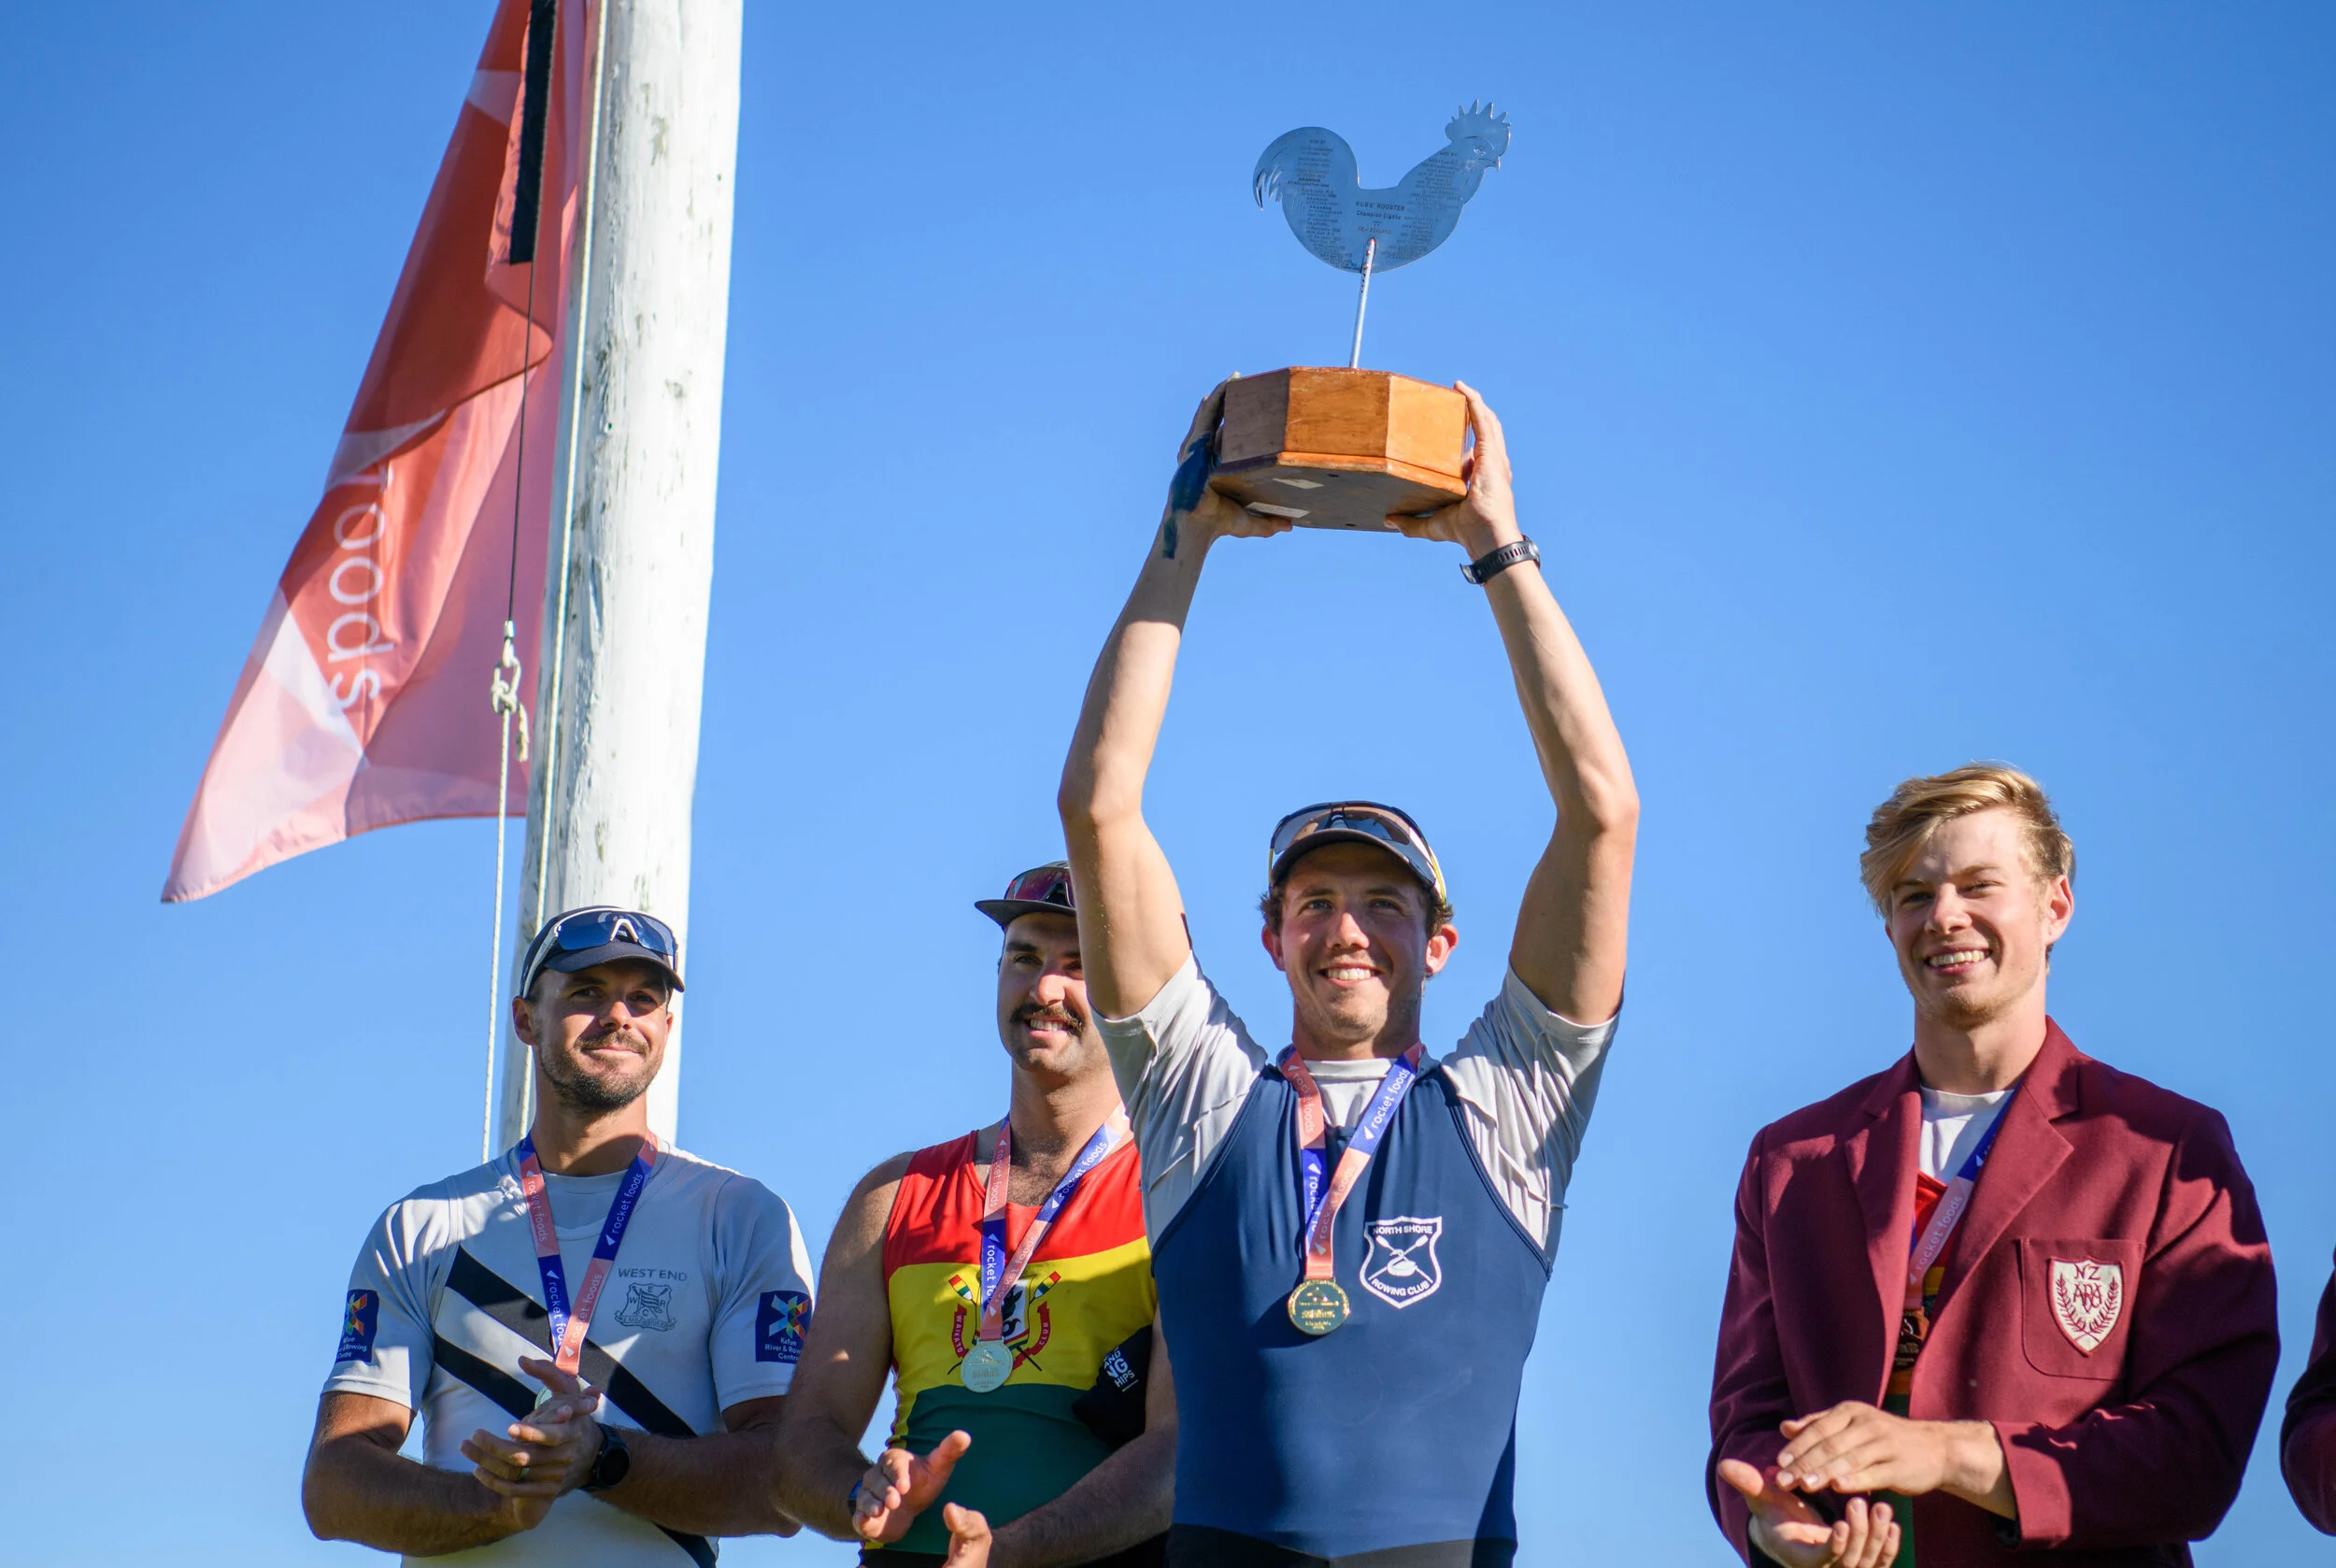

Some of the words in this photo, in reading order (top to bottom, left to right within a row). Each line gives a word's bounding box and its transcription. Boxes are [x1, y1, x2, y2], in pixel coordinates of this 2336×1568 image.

[1371, 1095, 1395, 1130] rocket
[1388, 1068, 1410, 1096] foods
[1303, 1103, 1315, 1133] foods
[993, 1150, 1004, 1181] rocket
[1059, 1168, 1086, 1200] rocket
[1082, 1141, 1107, 1167] foods
[611, 1199, 632, 1234] rocket
[623, 1173, 644, 1199] foods
[990, 1181, 1002, 1207] foods
[527, 1180, 541, 1210] rocket
[534, 1212, 547, 1242] foods
[1373, 1225, 1402, 1234] NORTH
[1403, 1224, 1433, 1234] SHORE
[1916, 1229, 1944, 1270] rocket
[1938, 1195, 1963, 1228] foods
[618, 1268, 656, 1278] WEST
[659, 1270, 688, 1282] END
[987, 1245, 997, 1282] rocket
[2074, 1263, 2101, 1281] NZ
[548, 1281, 564, 1319] rocket
[583, 1274, 603, 1304] foods
[1371, 1277, 1406, 1296] ROWING
[1407, 1280, 1431, 1295] CLUB
[555, 1322, 566, 1346] foo
[780, 1337, 797, 1346] Kafue
[954, 1315, 963, 1353] WAIKATO
[1038, 1322, 1049, 1346] CLUB
